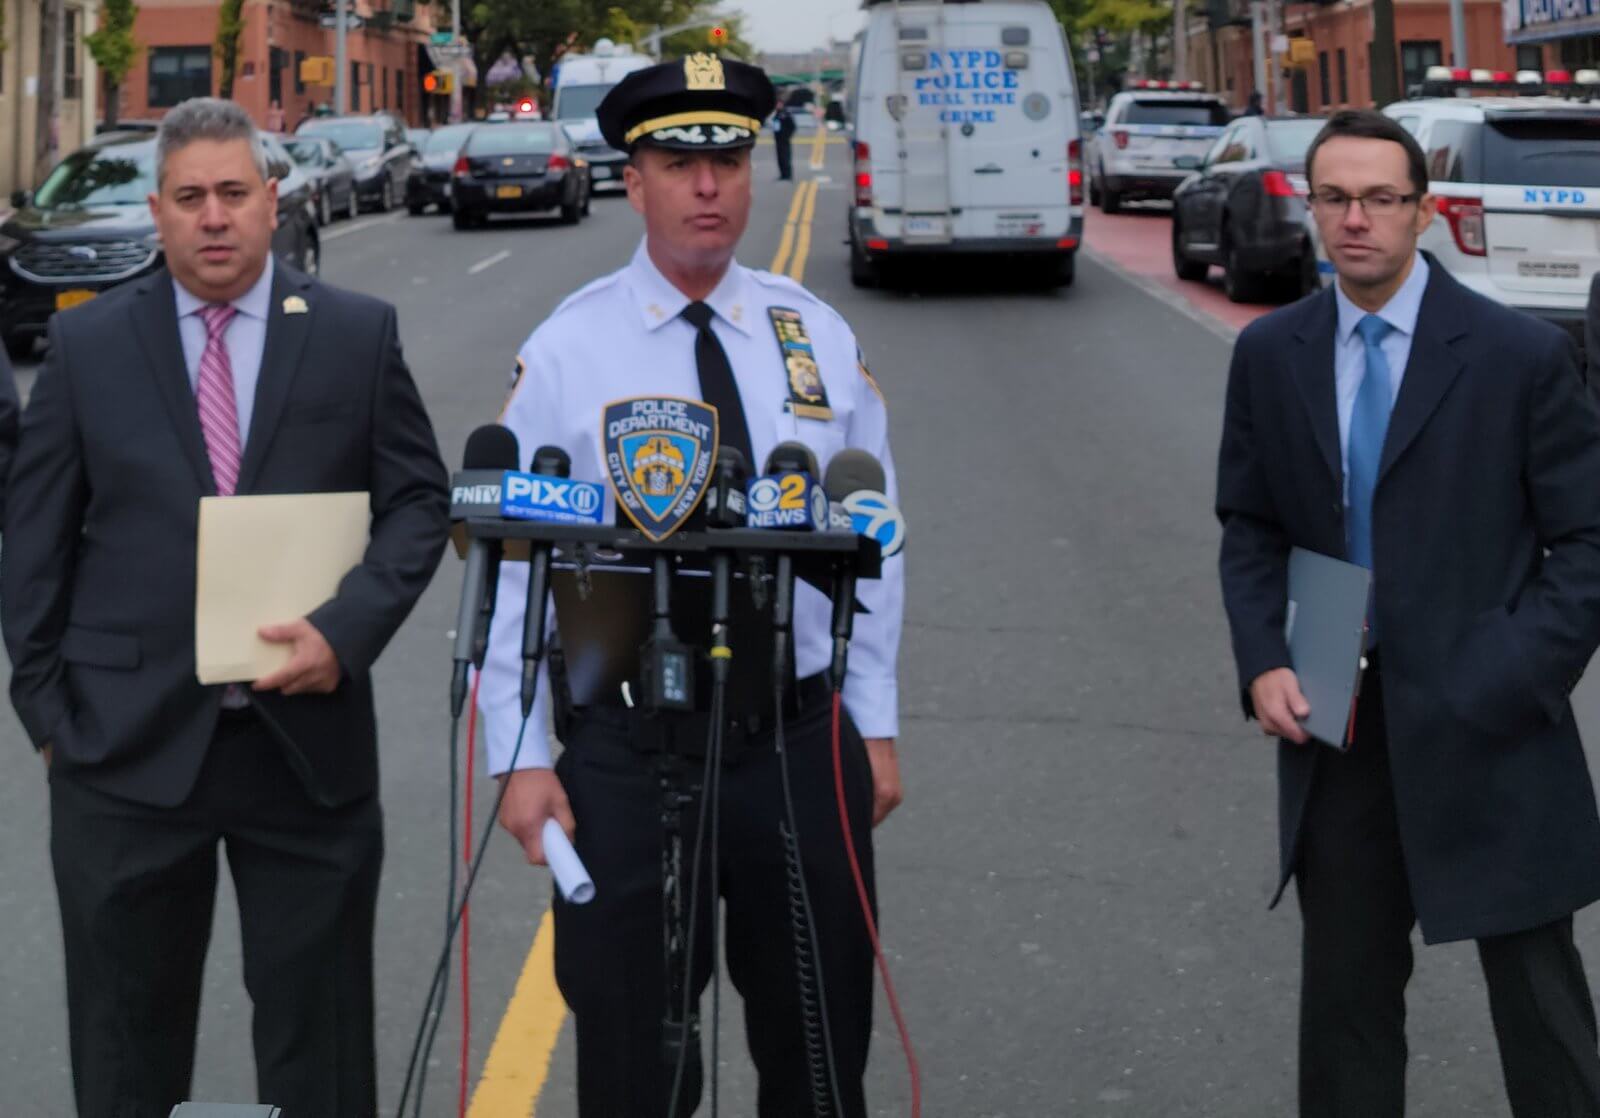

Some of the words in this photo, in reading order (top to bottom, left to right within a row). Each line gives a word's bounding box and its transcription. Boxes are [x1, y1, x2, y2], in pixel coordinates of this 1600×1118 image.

[929, 51, 1001, 68] NYPD
[919, 93, 964, 105] REAL
[972, 93, 1015, 105] TIME
[940, 110, 994, 122] CRIME
[1524, 190, 1585, 204] NYPD
[632, 400, 688, 417] POLICE
[609, 415, 711, 440] DEPARTMENT
[608, 452, 628, 488] CITY
[622, 489, 643, 510] OF
[672, 485, 698, 518] NEW
[691, 450, 711, 485] YORK
[507, 475, 570, 509] PIX
[778, 473, 807, 510] 2
[748, 508, 807, 527] NEWS
[829, 510, 853, 528] bc
